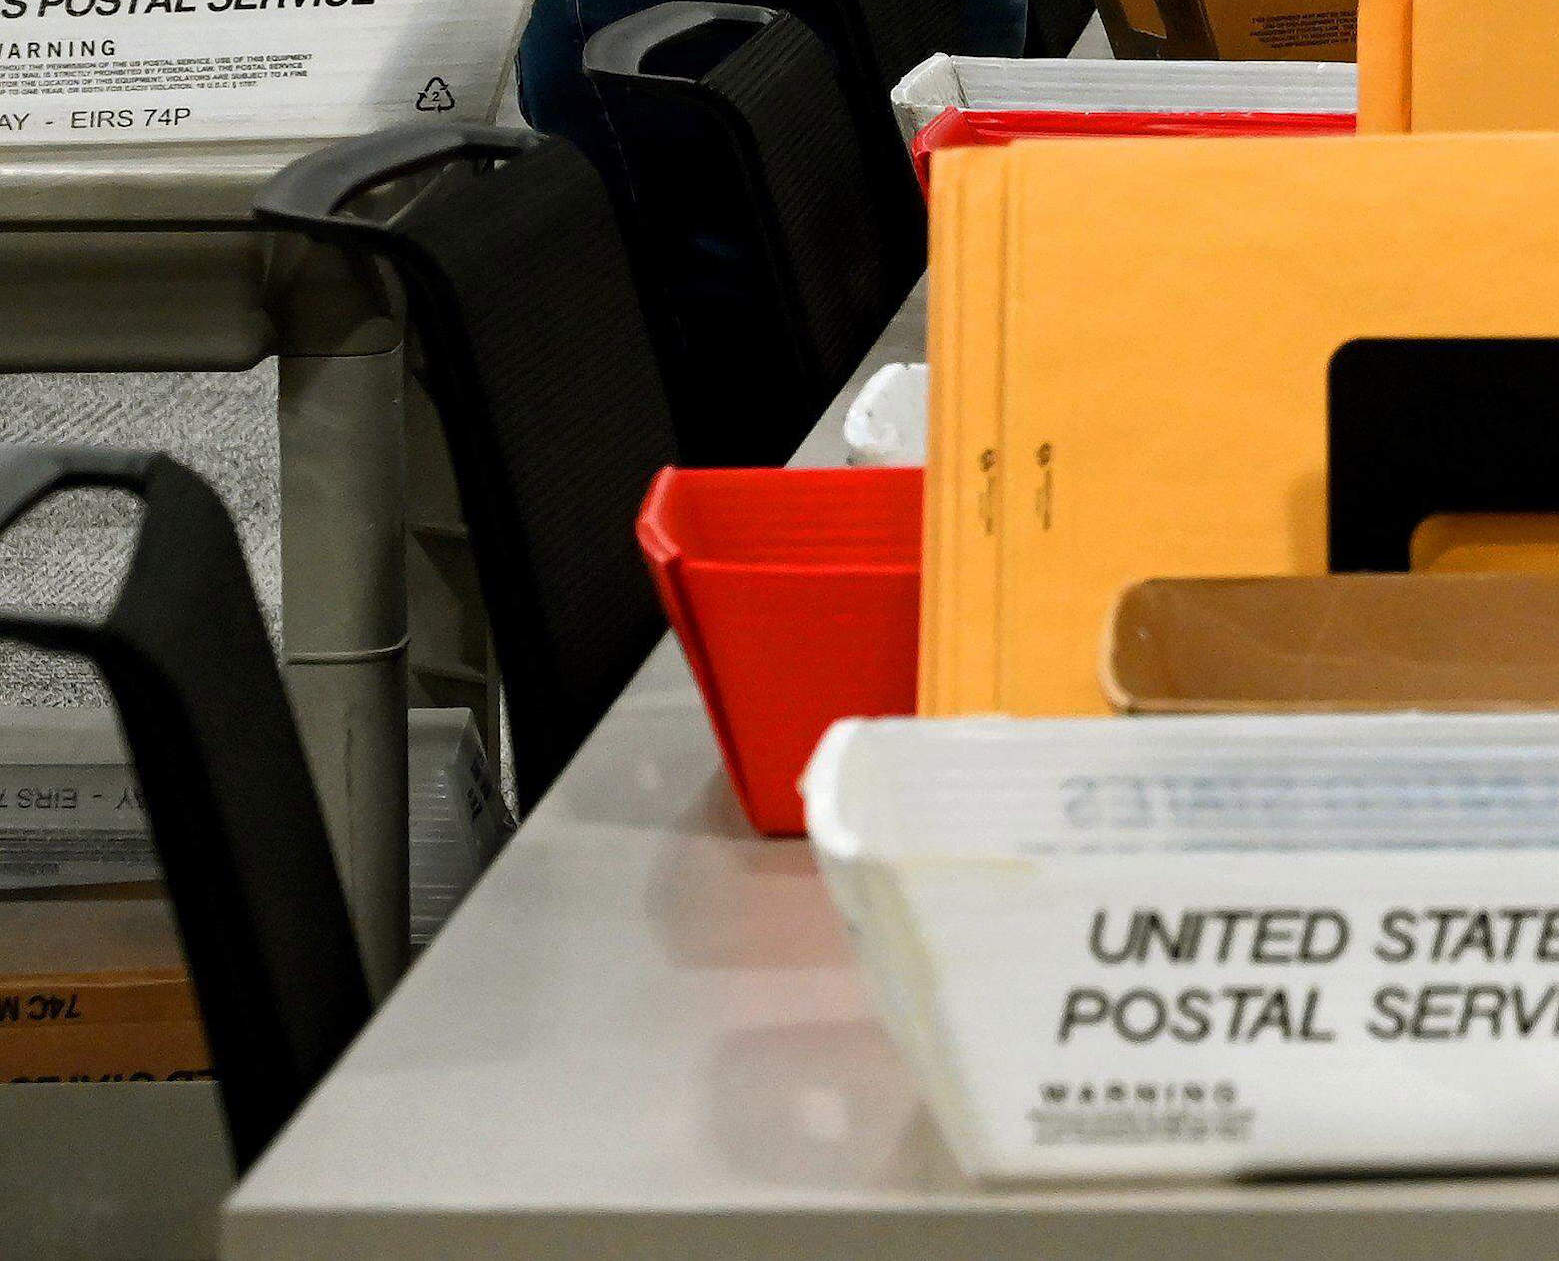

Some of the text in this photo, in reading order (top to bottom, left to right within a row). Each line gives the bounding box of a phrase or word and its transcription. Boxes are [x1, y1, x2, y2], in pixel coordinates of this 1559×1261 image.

[0, 39, 116, 59] ARNING
[71, 109, 134, 129] EIRS
[143, 107, 192, 128] 74P
[17, 785, 79, 810] EIRS
[1089, 906, 1351, 967] UNITED
[1056, 984, 1336, 1044] POSTAL
[1041, 1082, 1239, 1106] WARNING
